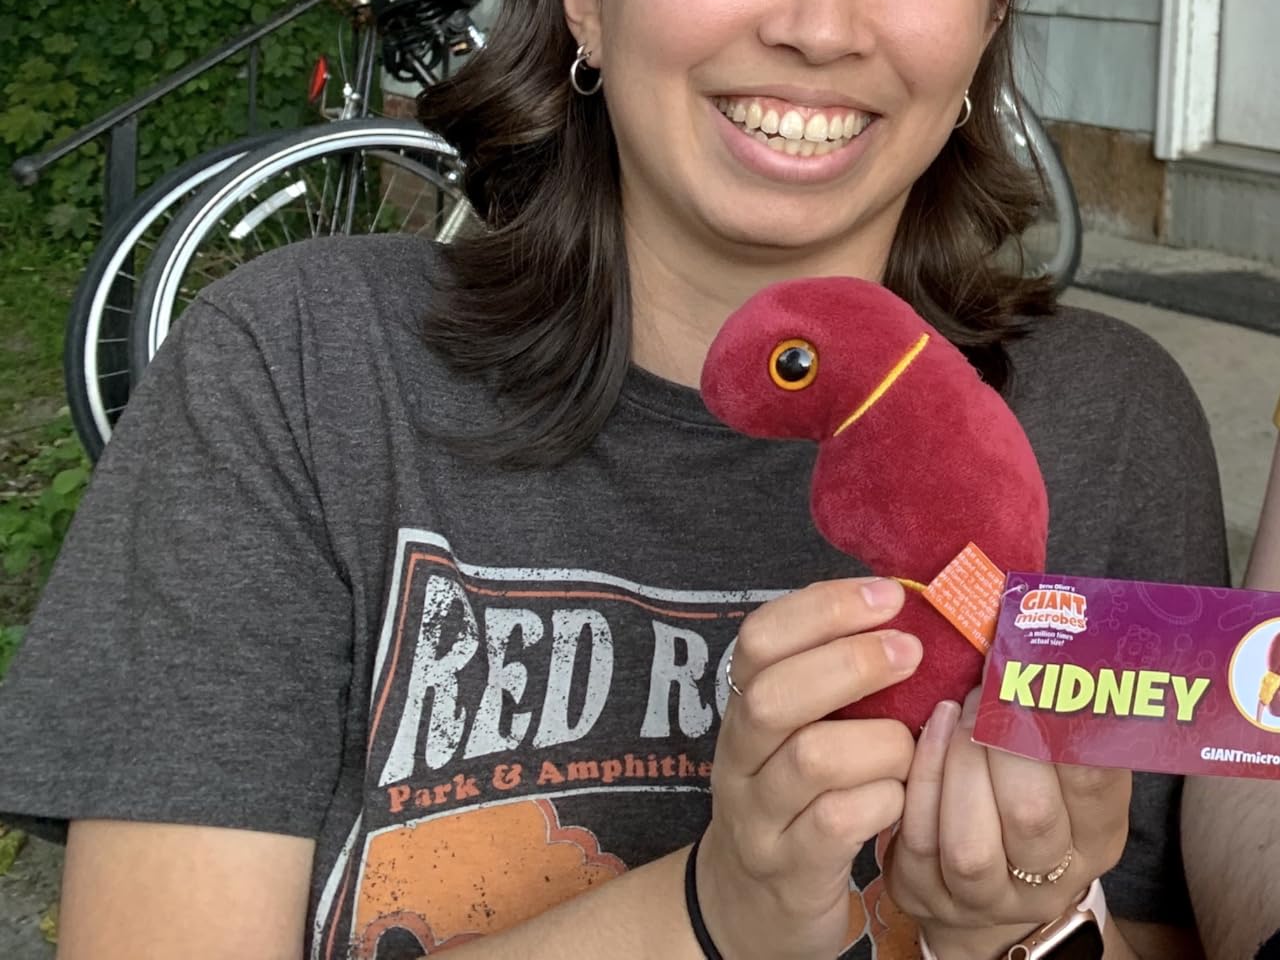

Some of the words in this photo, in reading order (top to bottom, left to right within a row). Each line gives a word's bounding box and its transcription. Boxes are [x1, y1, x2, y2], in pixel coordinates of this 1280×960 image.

[1017, 612, 1085, 629] microbes
[1022, 591, 1085, 616] GIANT
[378, 574, 614, 787] RED
[1000, 661, 1210, 721] KIDNEY
[387, 774, 481, 813] Park
[491, 763, 523, 790] &
